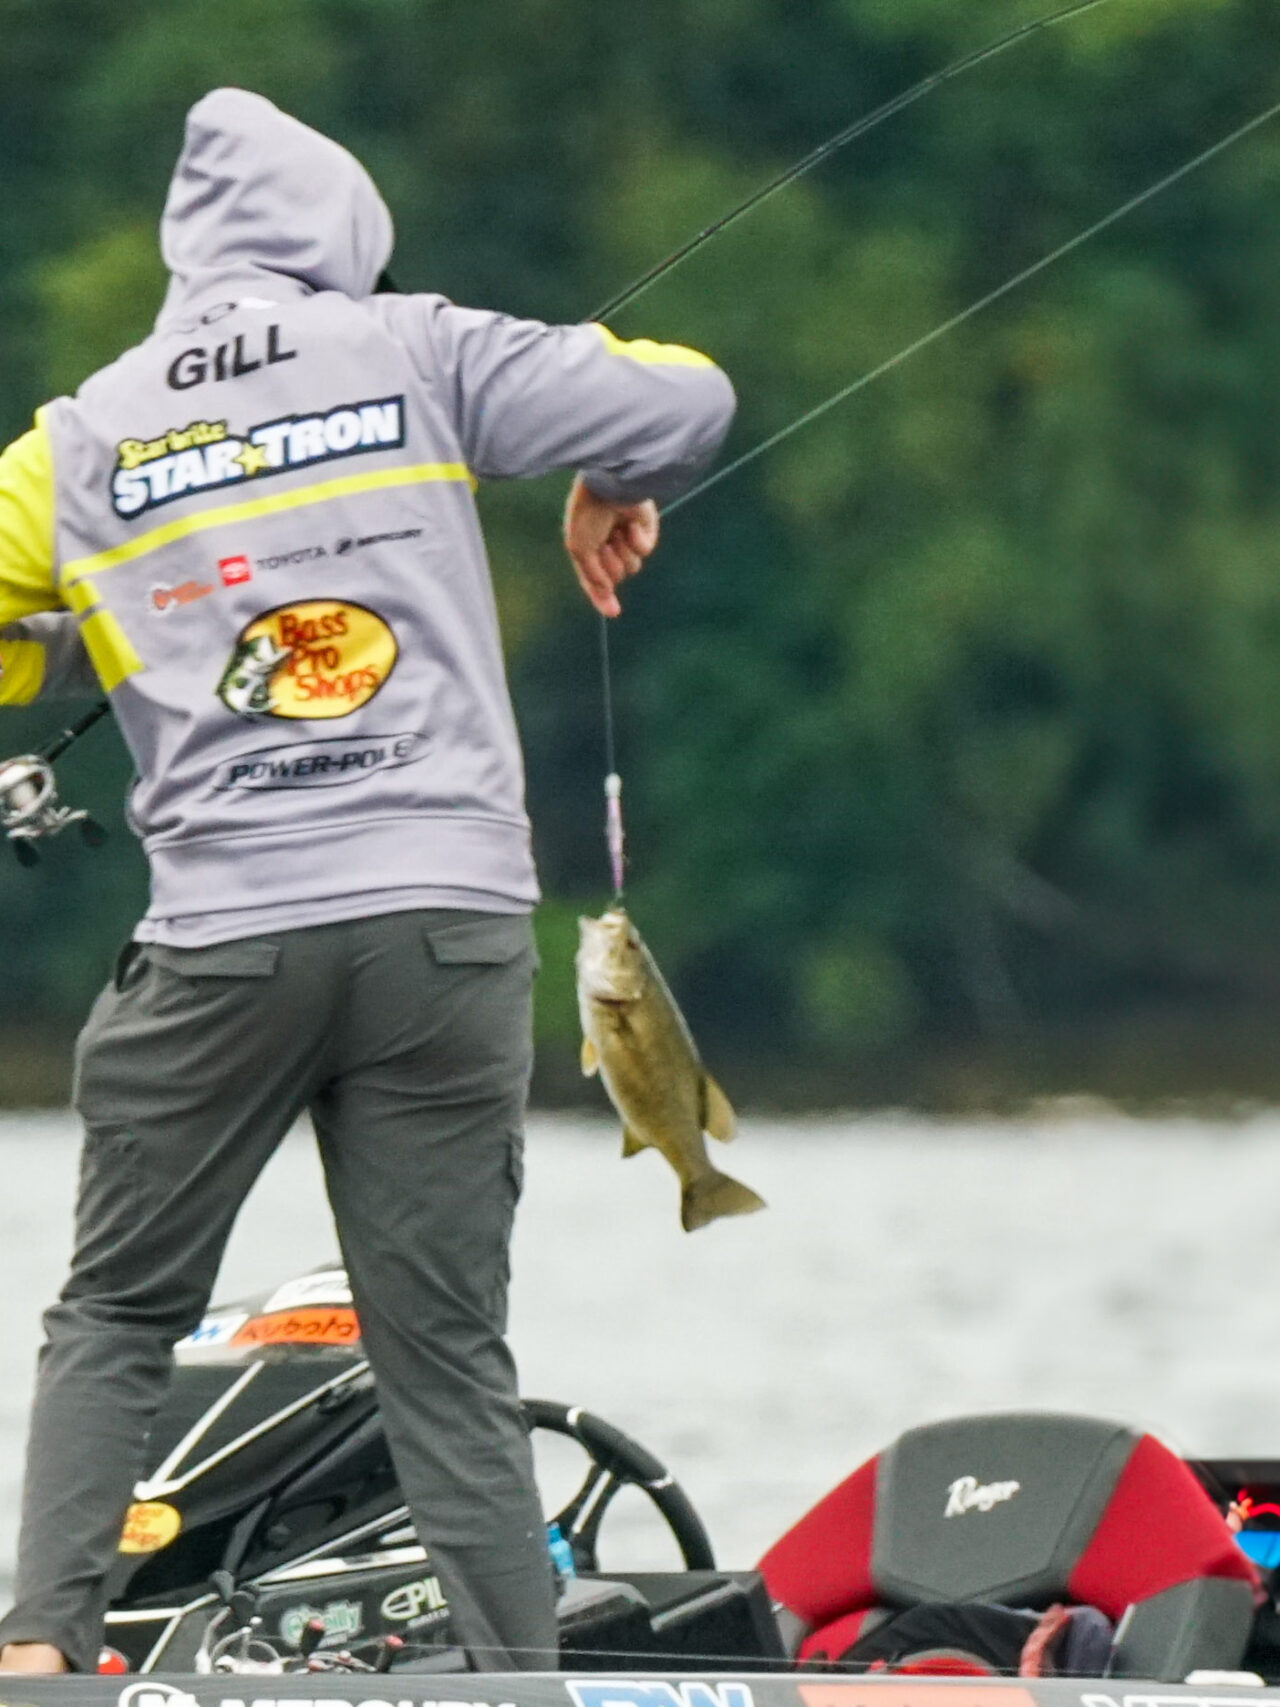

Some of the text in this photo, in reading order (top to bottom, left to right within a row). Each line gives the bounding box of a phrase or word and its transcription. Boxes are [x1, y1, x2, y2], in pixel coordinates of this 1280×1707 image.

[167, 323, 298, 391] GILL
[114, 402, 401, 514] STAR TRON
[256, 546, 328, 571] TOYOTA
[277, 610, 349, 648] Bass
[286, 644, 340, 677] Pro
[293, 664, 379, 702] Shops
